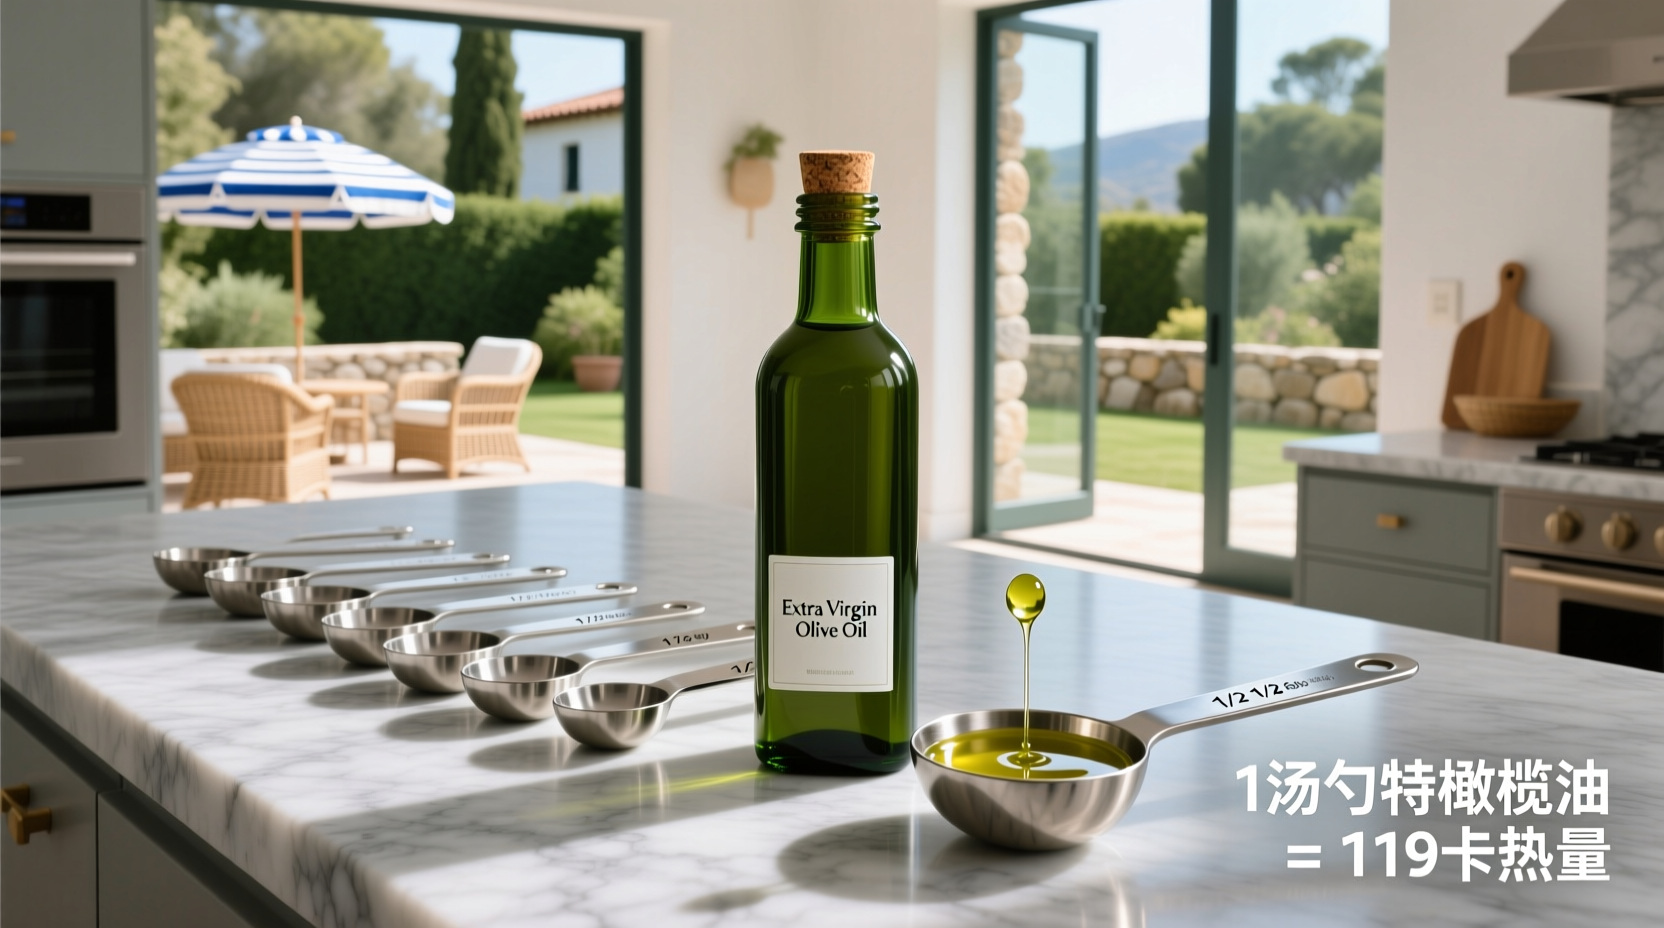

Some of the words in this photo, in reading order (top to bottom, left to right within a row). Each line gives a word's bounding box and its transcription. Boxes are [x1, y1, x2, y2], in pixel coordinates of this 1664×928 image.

[782, 599, 824, 616] Extra
[826, 599, 877, 622] Virgin
[795, 620, 839, 638] Olive
[842, 620, 867, 638] Oil
